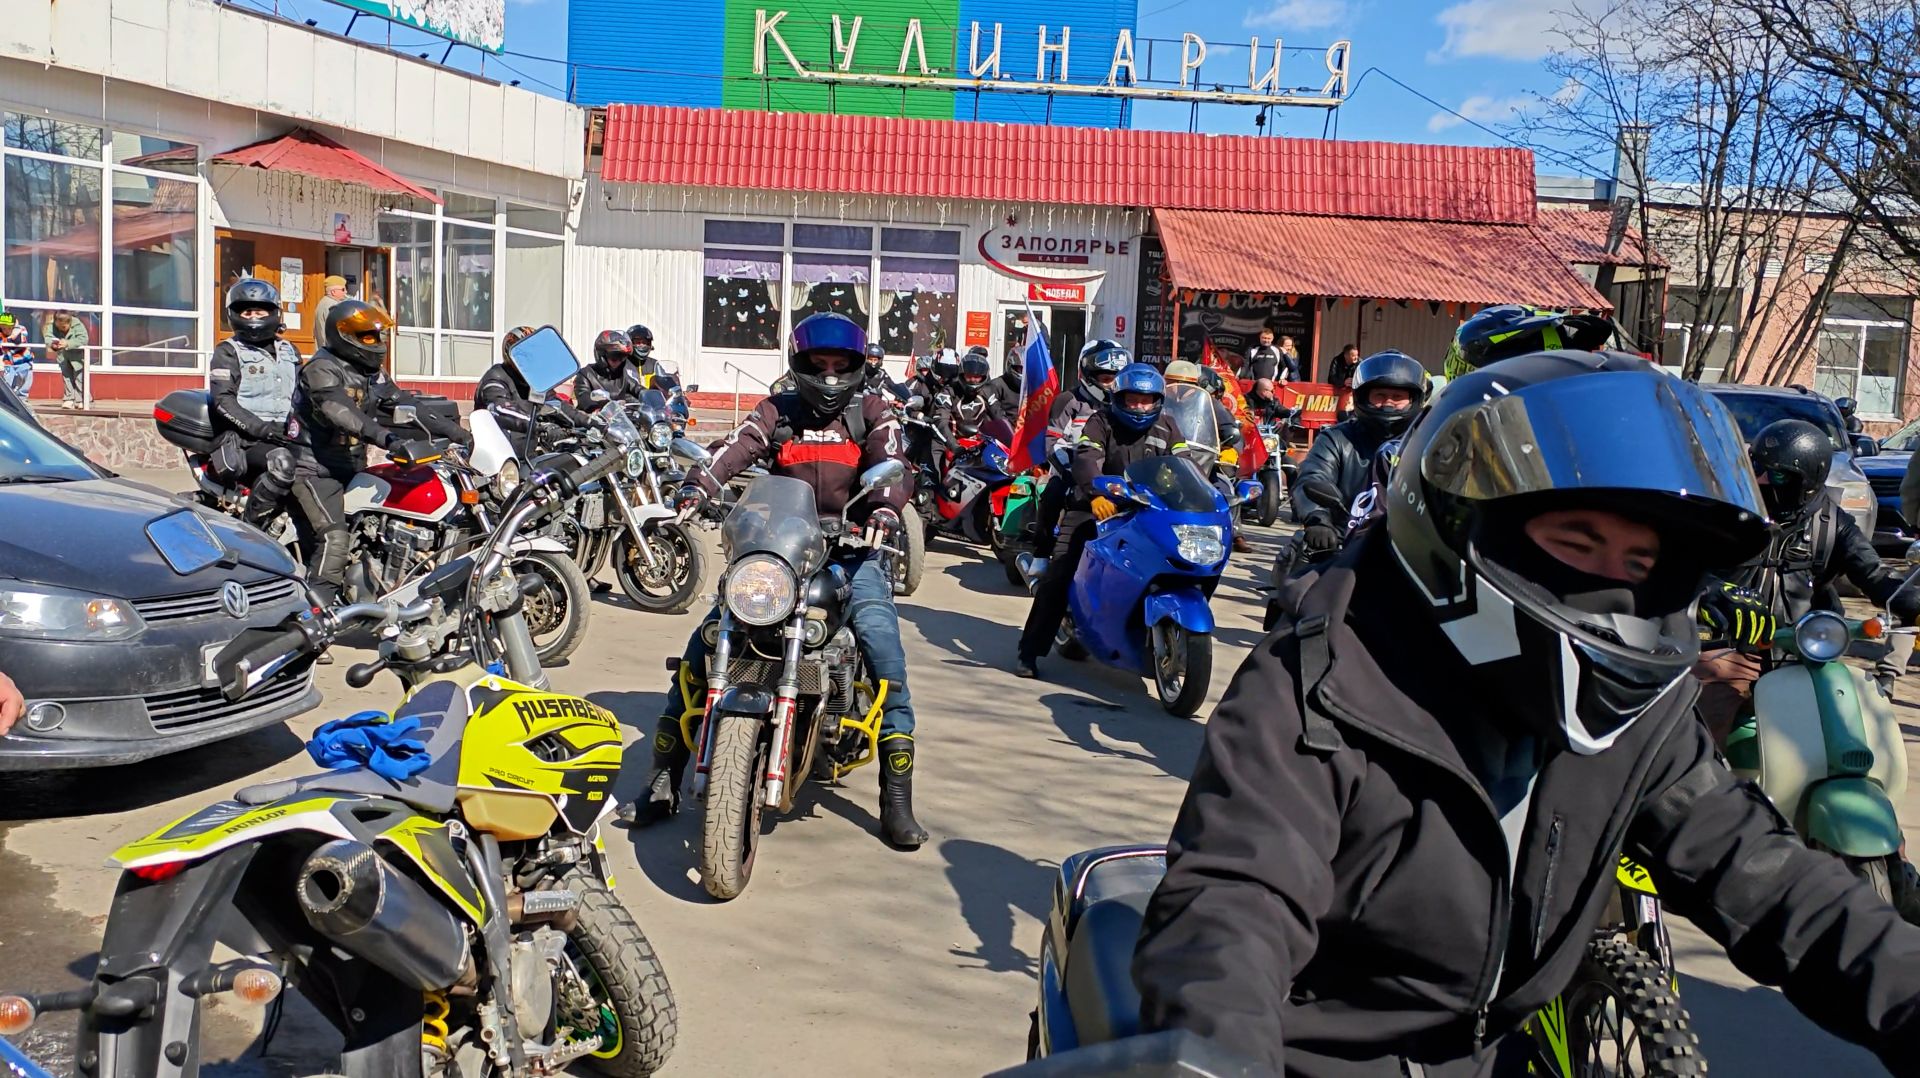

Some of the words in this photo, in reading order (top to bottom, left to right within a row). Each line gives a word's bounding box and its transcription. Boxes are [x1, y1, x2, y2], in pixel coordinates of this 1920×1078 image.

[753, 8, 1352, 96] КУЛИНАРИЯ
[1001, 235, 1130, 255] ЗАПОЛЯРЬЕ
[1045, 288, 1080, 299] ПОБЕДА!
[1115, 316, 1126, 333] 9
[1295, 394, 1306, 410] 9
[489, 767, 506, 777] PRO
[507, 772, 535, 786] CIRCUIT
[223, 808, 288, 834] DUNLOP
